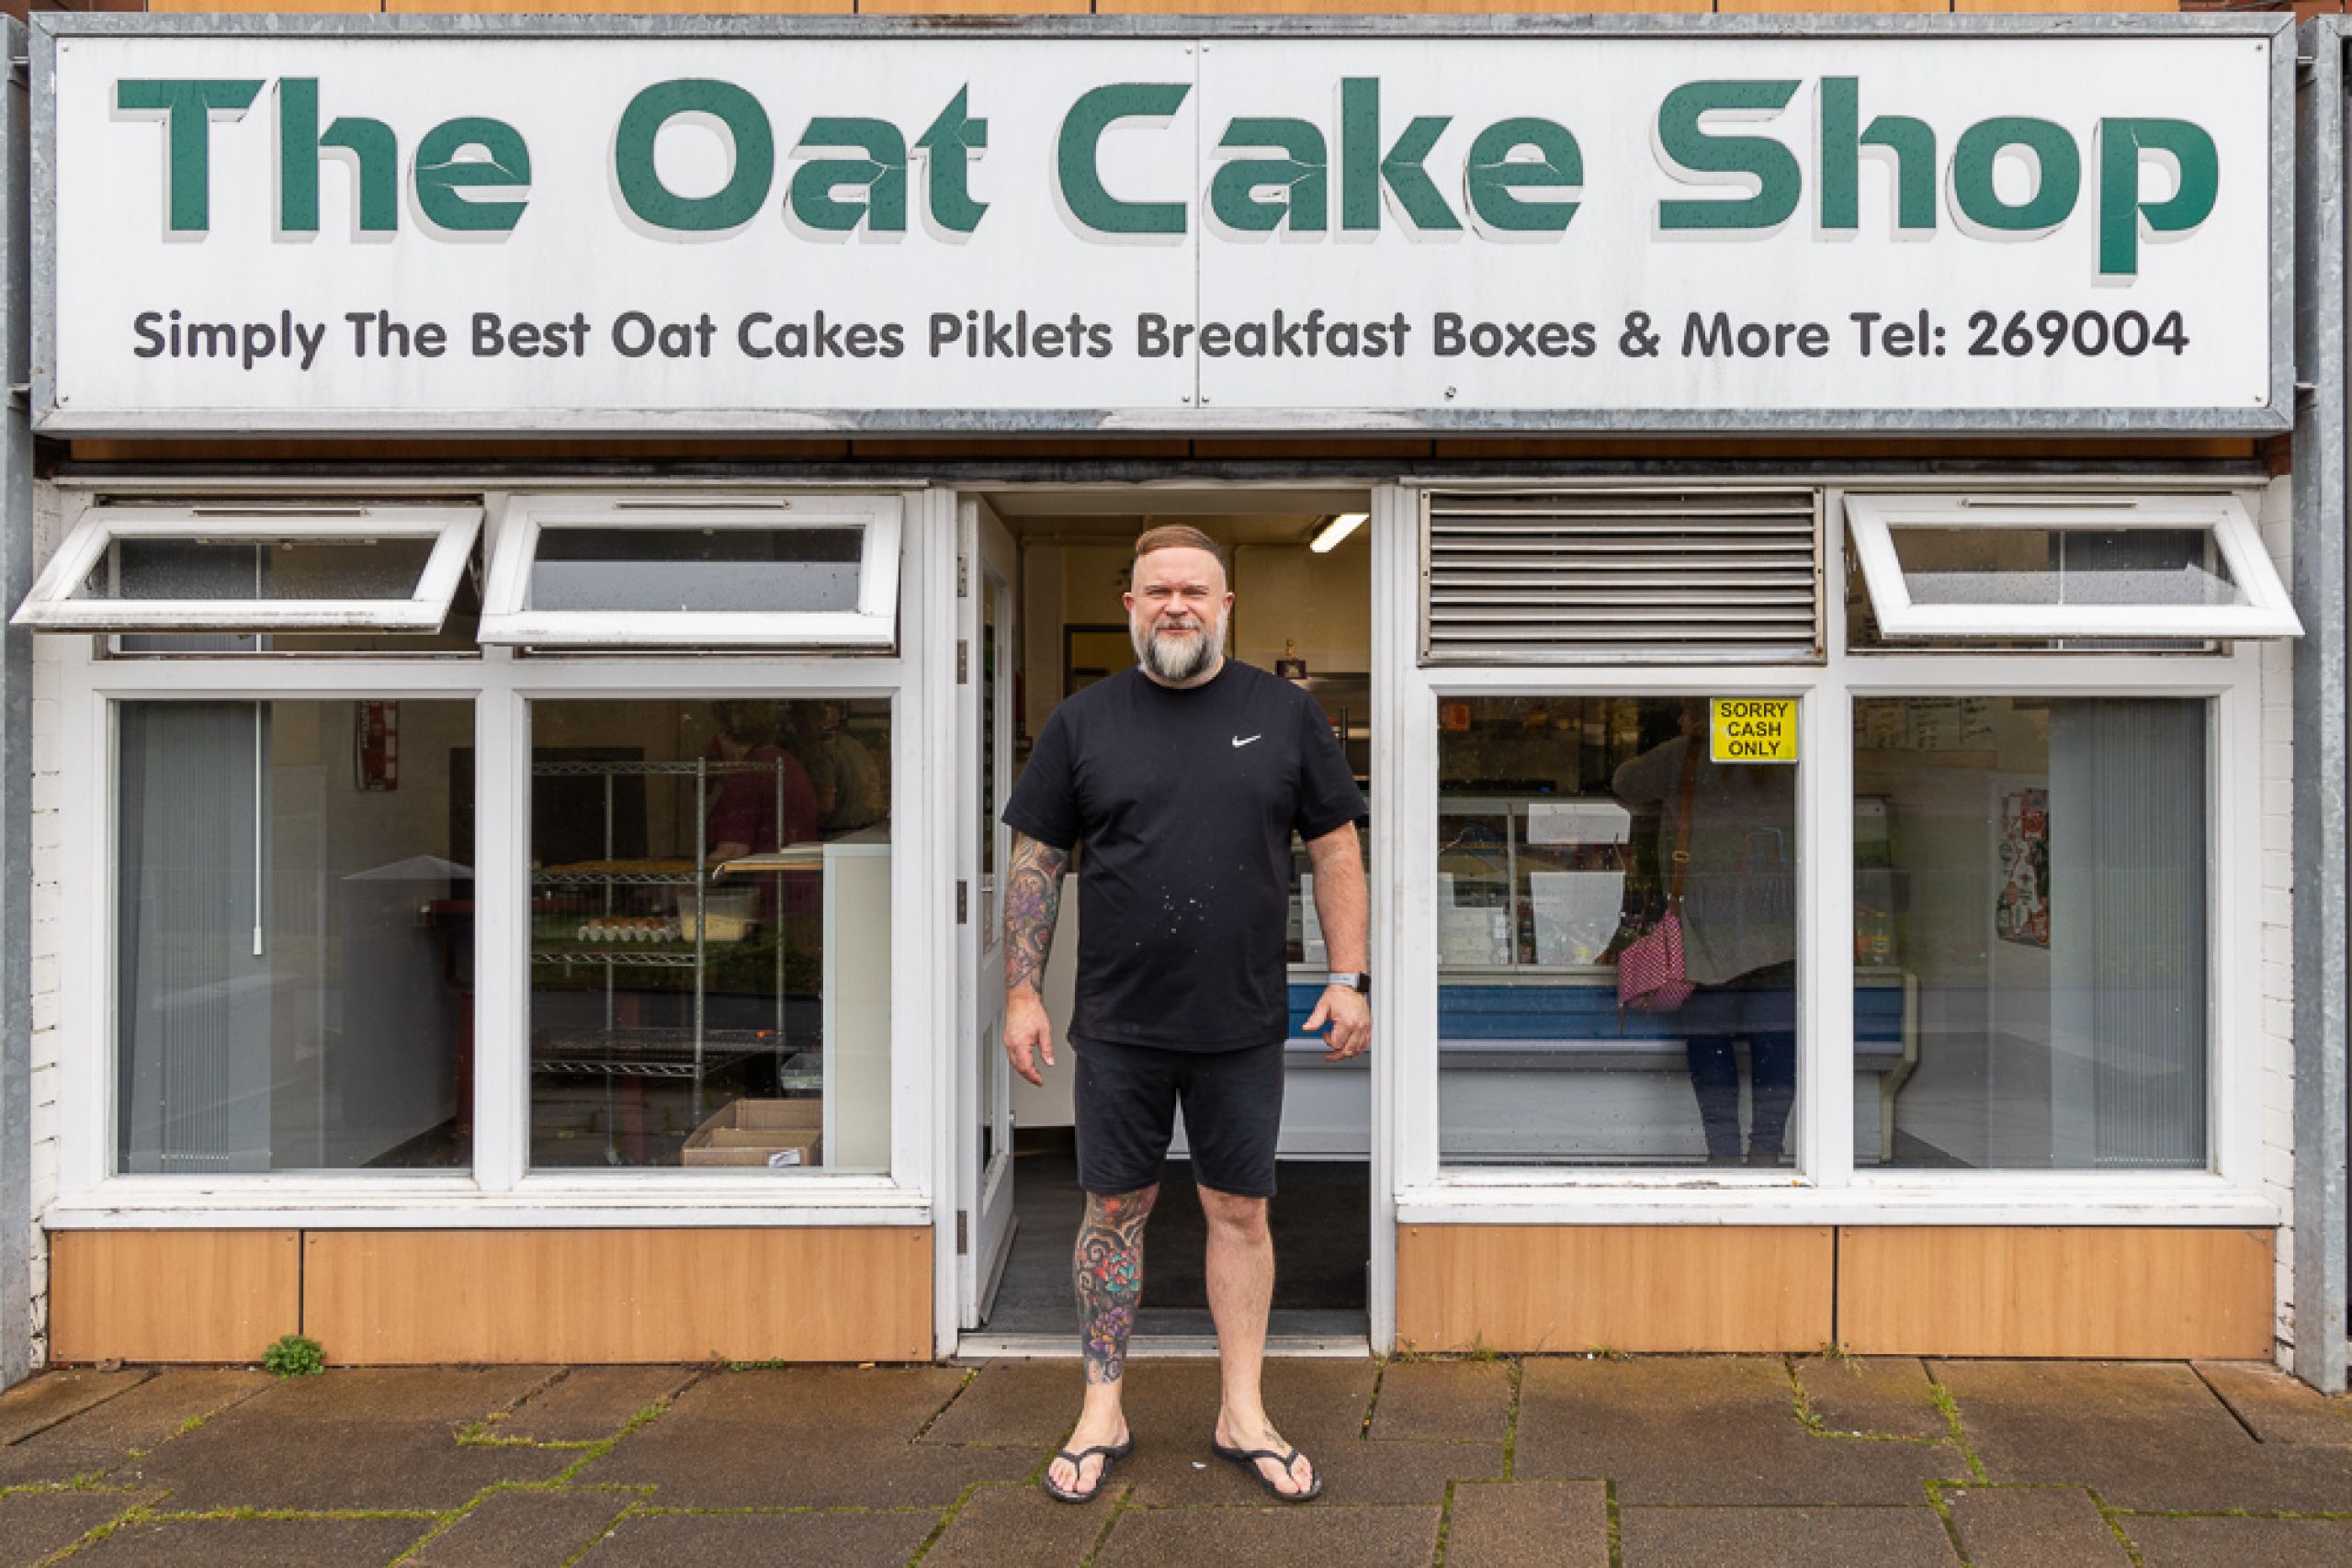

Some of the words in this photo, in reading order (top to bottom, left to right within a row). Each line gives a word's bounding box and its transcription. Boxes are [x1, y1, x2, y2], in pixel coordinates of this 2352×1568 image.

[116, 77, 532, 232] The
[613, 78, 989, 233] Oat
[1057, 77, 1584, 234] Cake
[1657, 77, 2220, 276] Shop
[133, 310, 325, 370] Simply
[345, 310, 447, 358] The
[472, 312, 591, 358] Best
[611, 311, 717, 358] Oat
[738, 310, 904, 358] Cakes
[930, 310, 1114, 358] Piklets
[1137, 310, 1412, 358] Breakfast
[1434, 311, 1596, 358] Boxes
[1620, 310, 1659, 358] &
[1681, 311, 1830, 358] More
[1850, 310, 1946, 358] Tel:
[1968, 310, 2190, 358] 269004
[1721, 702, 1788, 717] SORRY
[1728, 721, 1781, 737] CASH
[1728, 740, 1781, 756] ONLY
